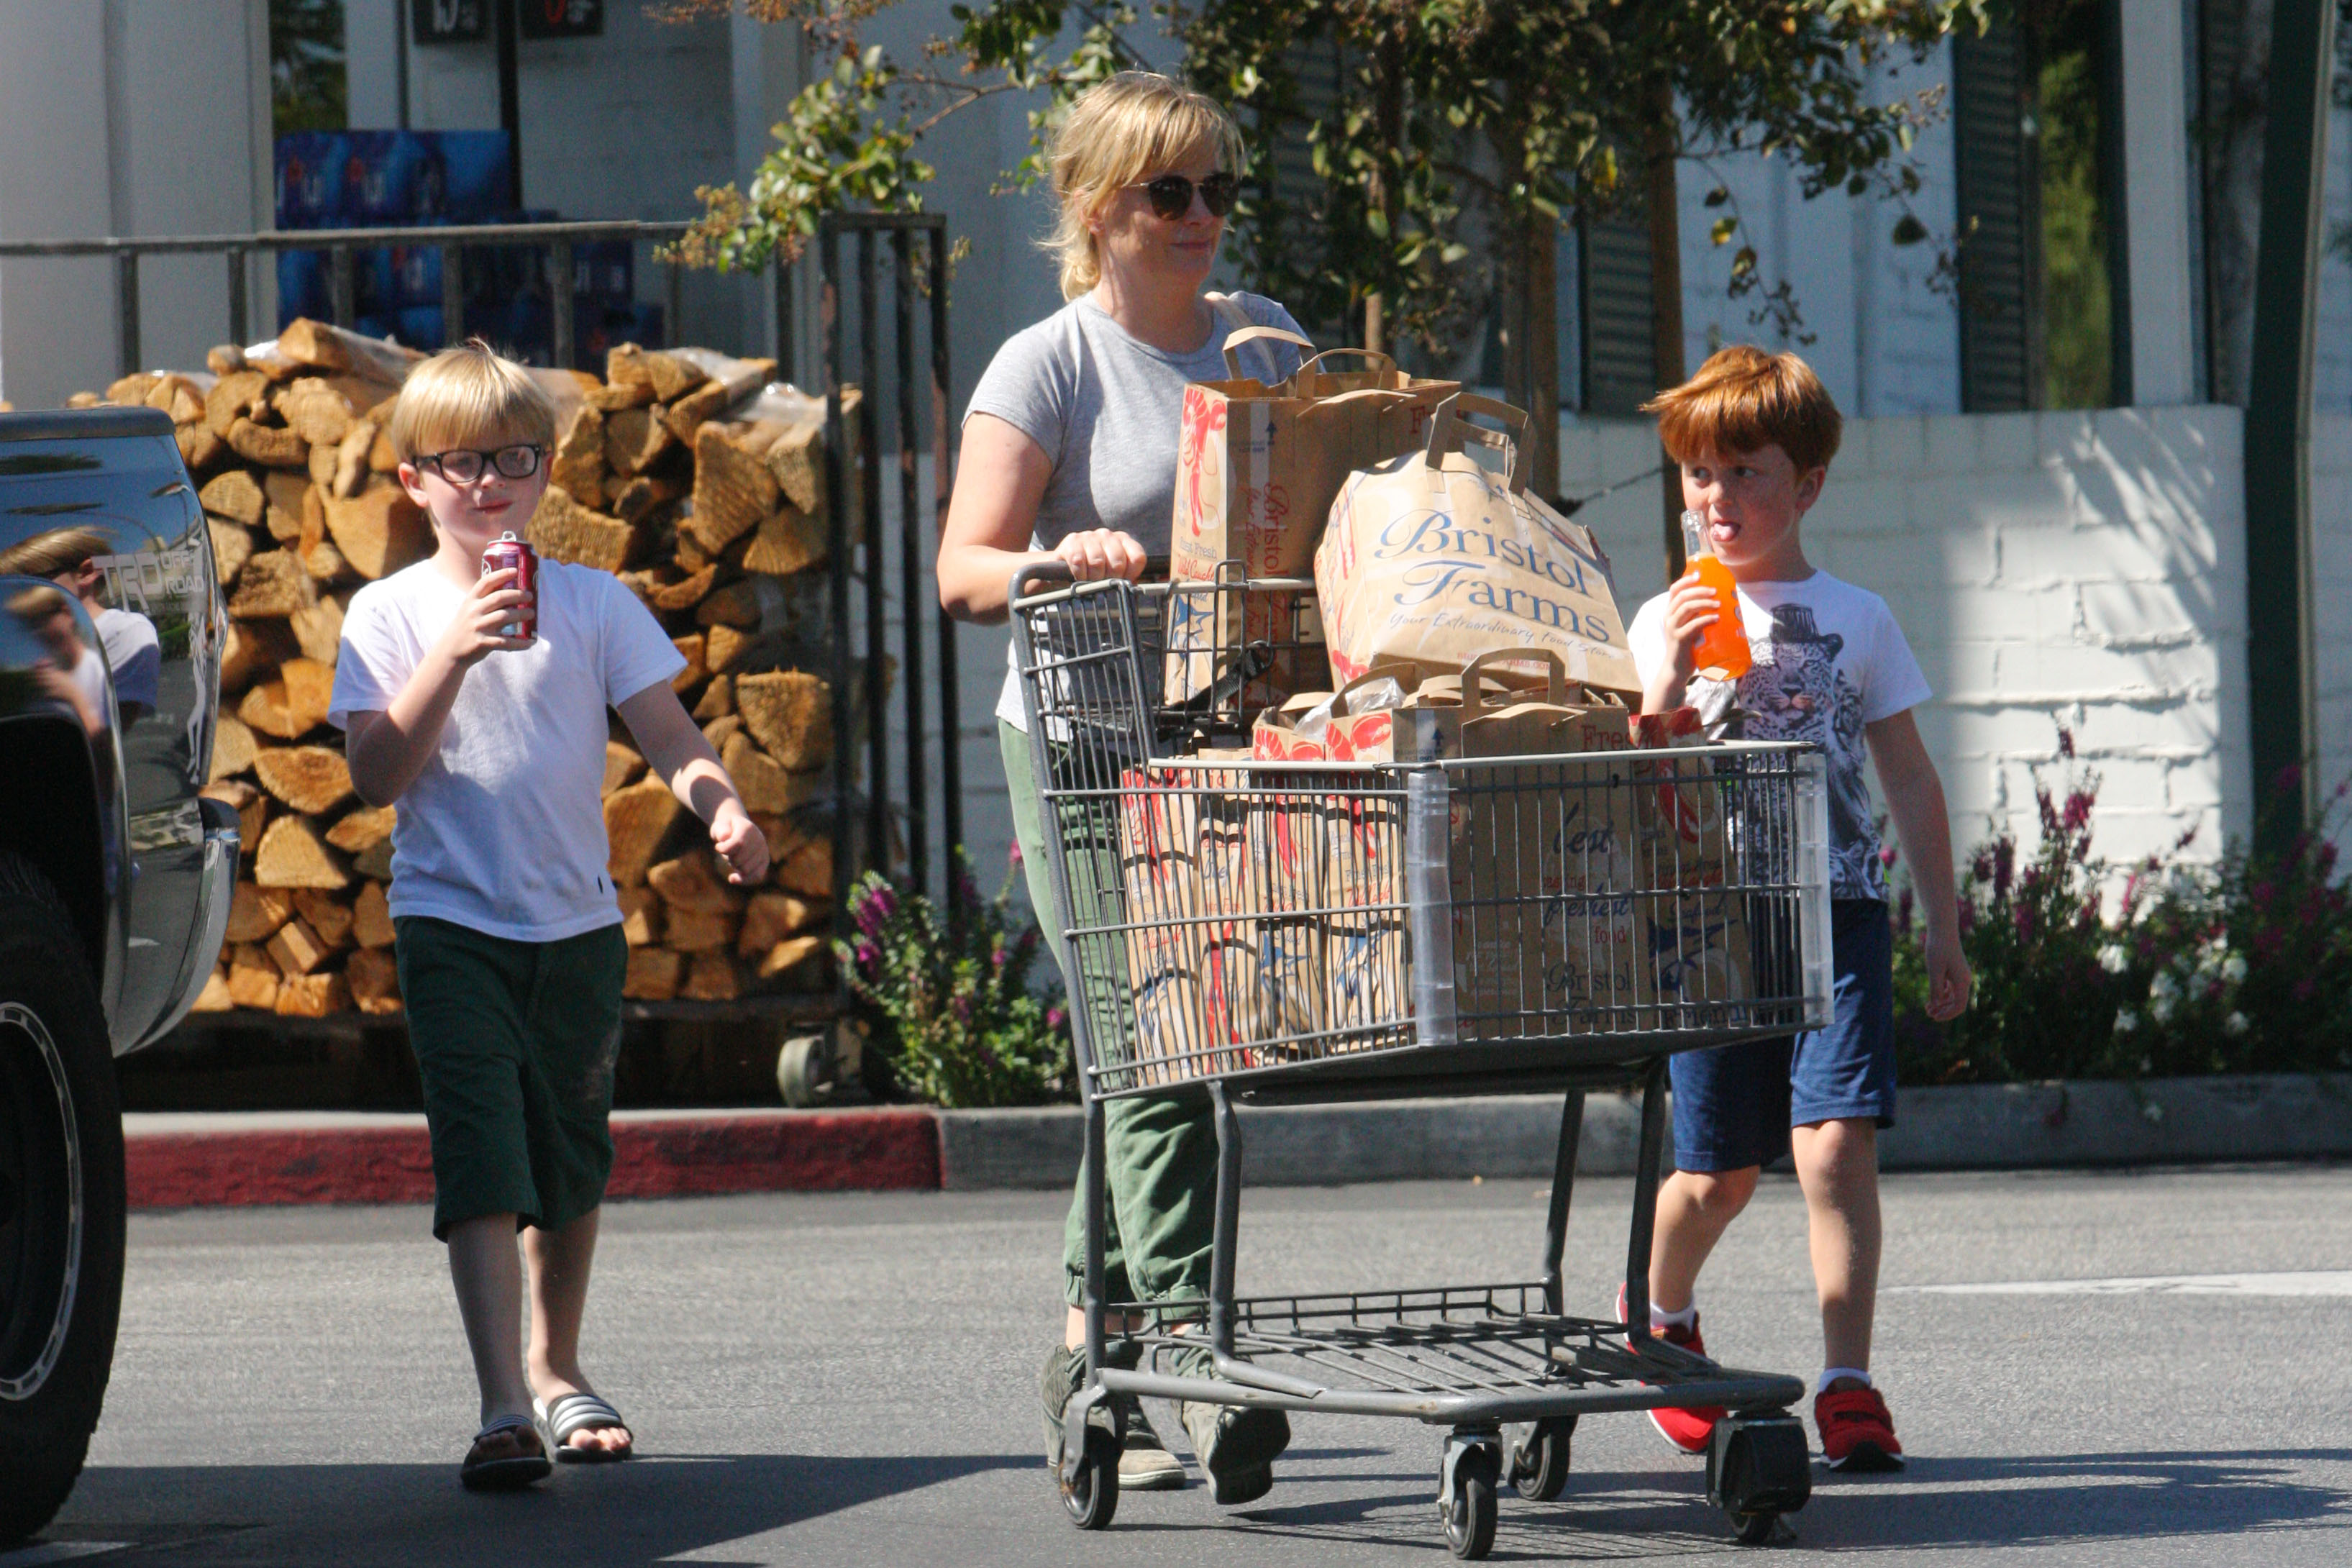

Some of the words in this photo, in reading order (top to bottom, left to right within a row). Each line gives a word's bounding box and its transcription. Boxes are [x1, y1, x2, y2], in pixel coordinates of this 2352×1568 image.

[1263, 481, 1290, 575] Bristol
[1375, 509, 1595, 599] Bristol
[91, 552, 163, 616] TRD
[165, 575, 205, 595] ROAD
[1395, 560, 1610, 642] Farms
[1390, 611, 1426, 629] Your
[1432, 612, 1535, 643] Extraordinary
[1541, 631, 1573, 647] Food
[1581, 724, 1637, 750] Fre
[1594, 925, 1627, 944] food
[1546, 959, 1633, 992] Brstol
